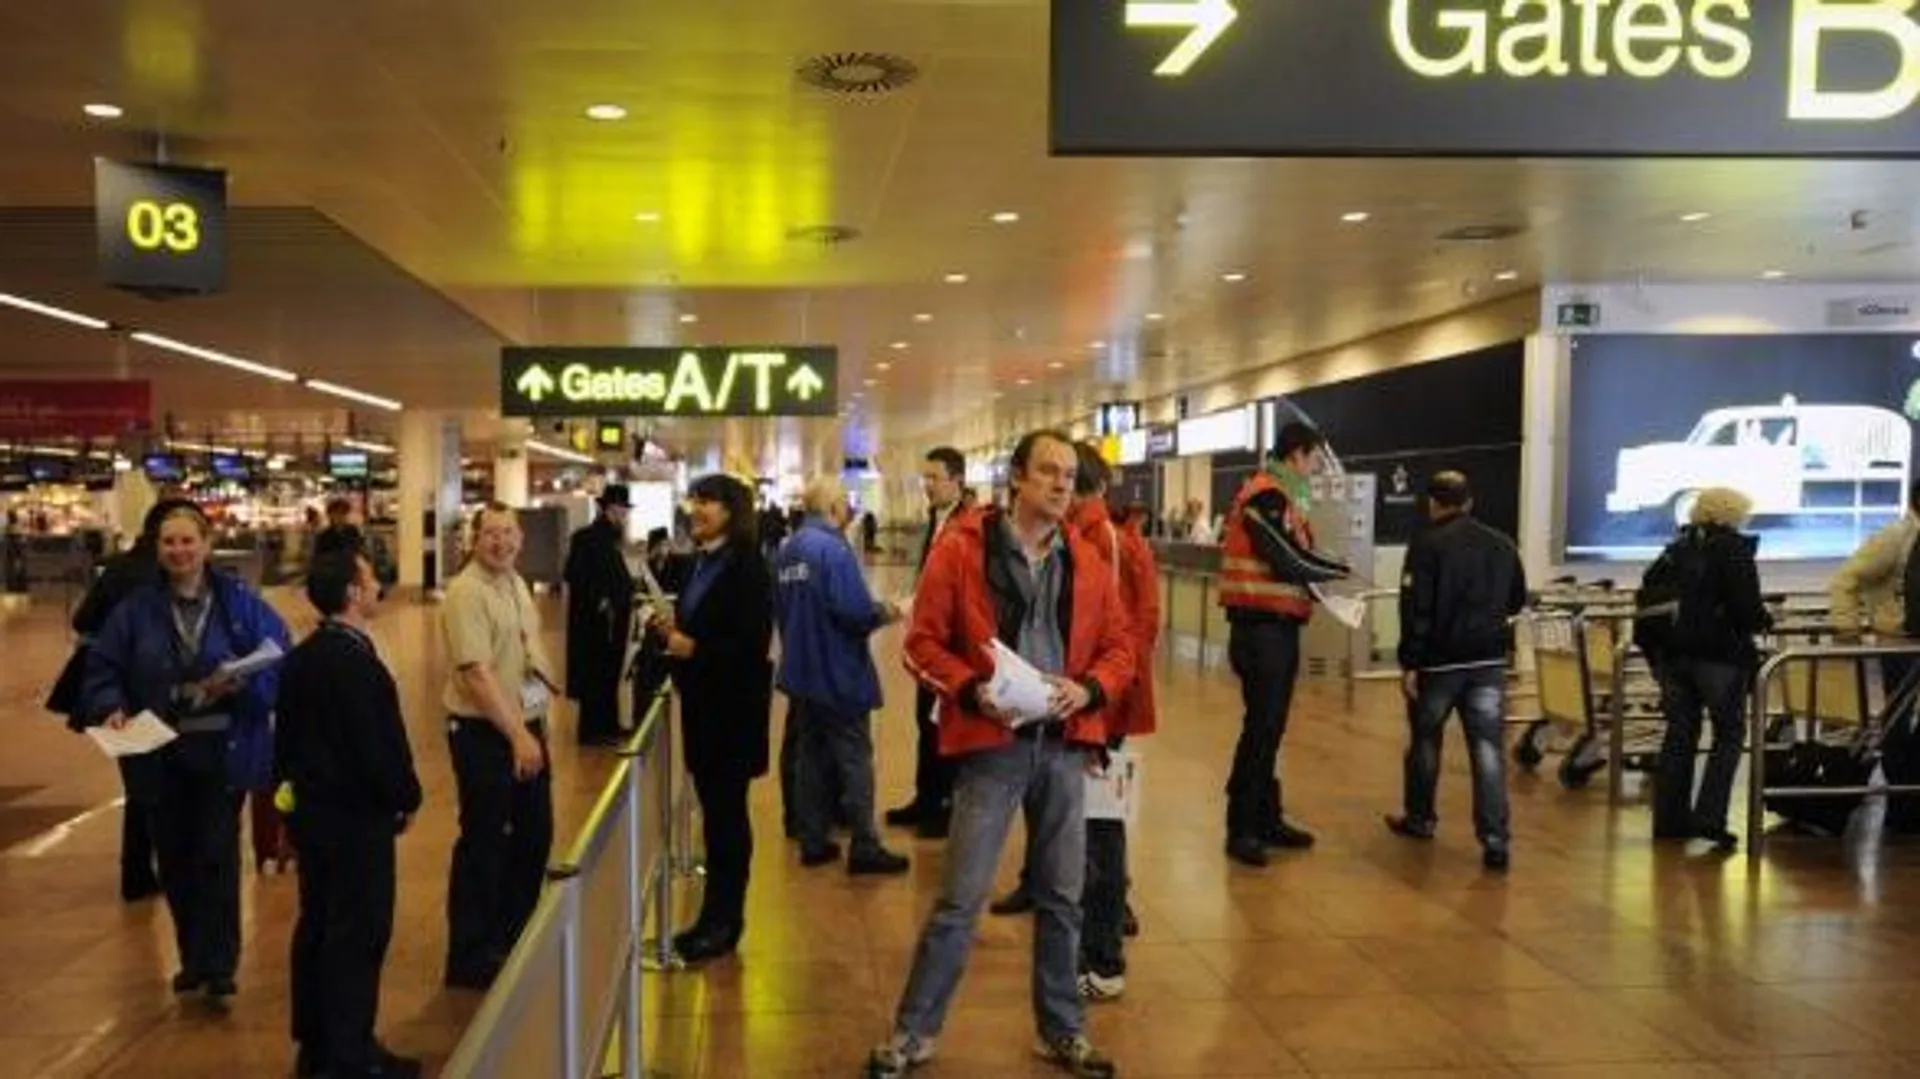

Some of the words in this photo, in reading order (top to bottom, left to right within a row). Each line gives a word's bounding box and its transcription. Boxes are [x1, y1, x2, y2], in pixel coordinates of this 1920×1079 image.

[1388, 0, 1752, 78] Gates
[127, 201, 198, 251] 03
[560, 363, 666, 400] Gates
[663, 352, 787, 411] A/T
